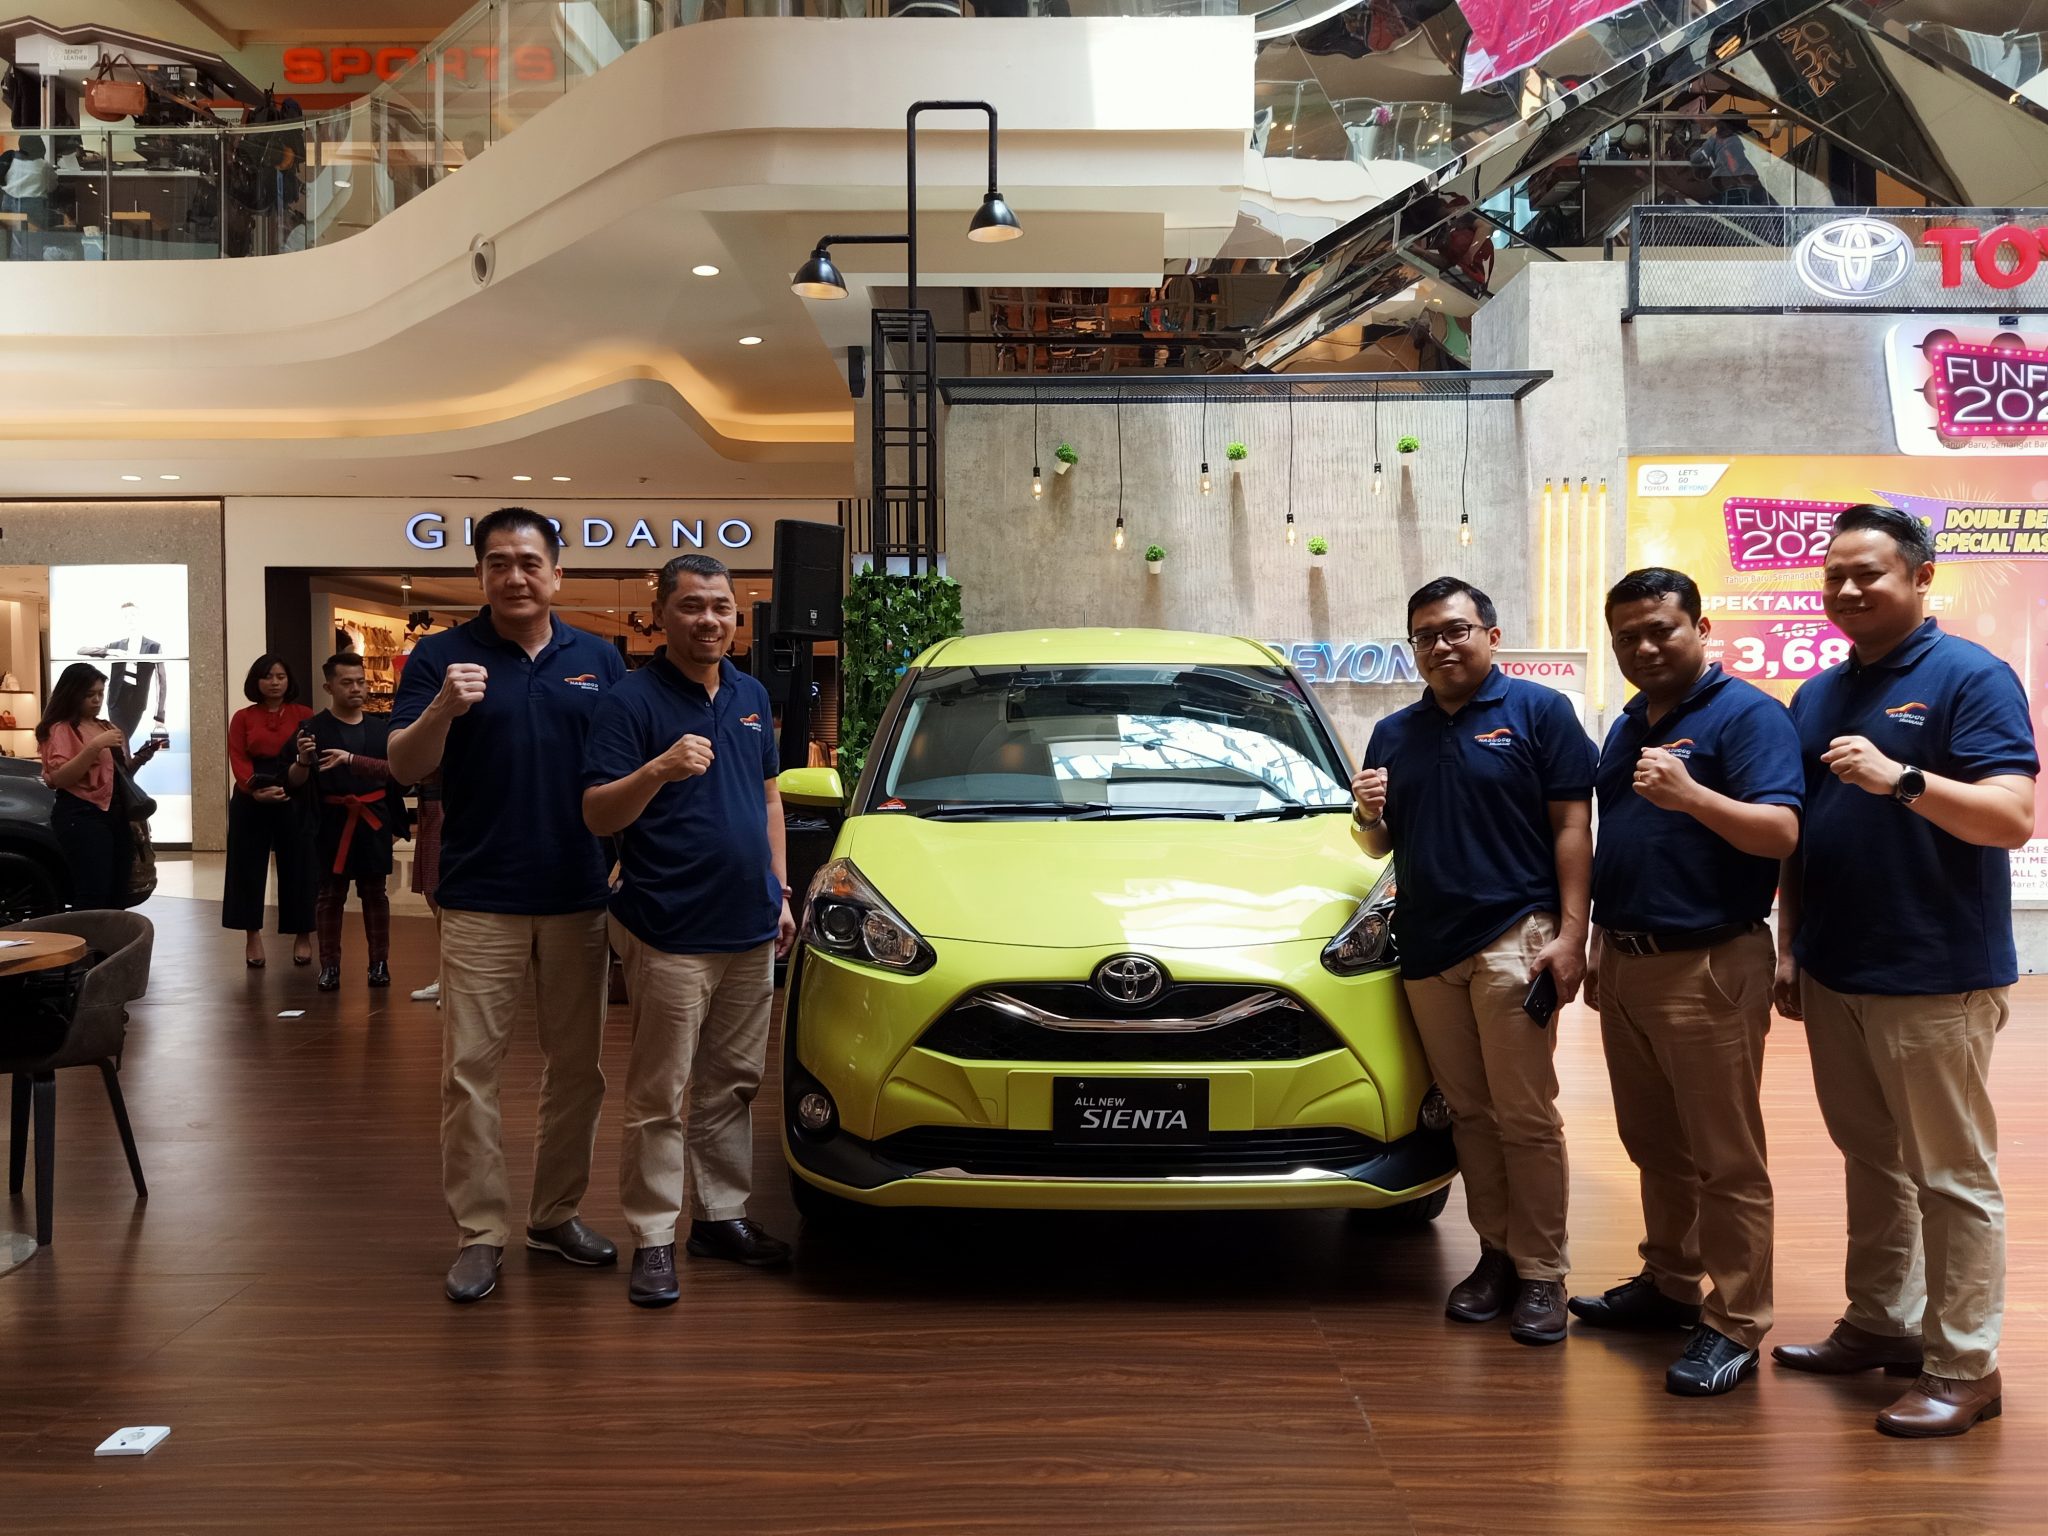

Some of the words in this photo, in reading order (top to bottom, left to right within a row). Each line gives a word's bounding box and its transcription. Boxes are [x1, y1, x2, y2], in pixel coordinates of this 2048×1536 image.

[282, 46, 556, 84] SPORTS
[1946, 356, 2048, 388] FUNF
[1942, 440, 1966, 449] Tahun
[1991, 440, 2032, 450] Semangat
[2034, 440, 2048, 449] Bar
[1734, 508, 1843, 531] FUNFE
[1944, 507, 2022, 531] DOUBLE
[2022, 507, 2048, 531] BE
[405, 512, 754, 550] GIRDANO
[1933, 531, 2011, 554] SPECIAL
[2012, 531, 2048, 554] NAS
[1741, 530, 1832, 561] 202
[1725, 576, 1749, 585] Tahun
[1773, 572, 1812, 582] Semangat
[1700, 595, 1825, 611] SPEKTAKU
[1265, 642, 1421, 684] EYON
[1731, 636, 1851, 679] 3,68
[1501, 663, 1576, 676] TOYOTA
[1074, 1097, 1096, 1106] ALL
[1098, 1097, 1126, 1107] NEW
[1080, 1109, 1188, 1129] SIENTA
